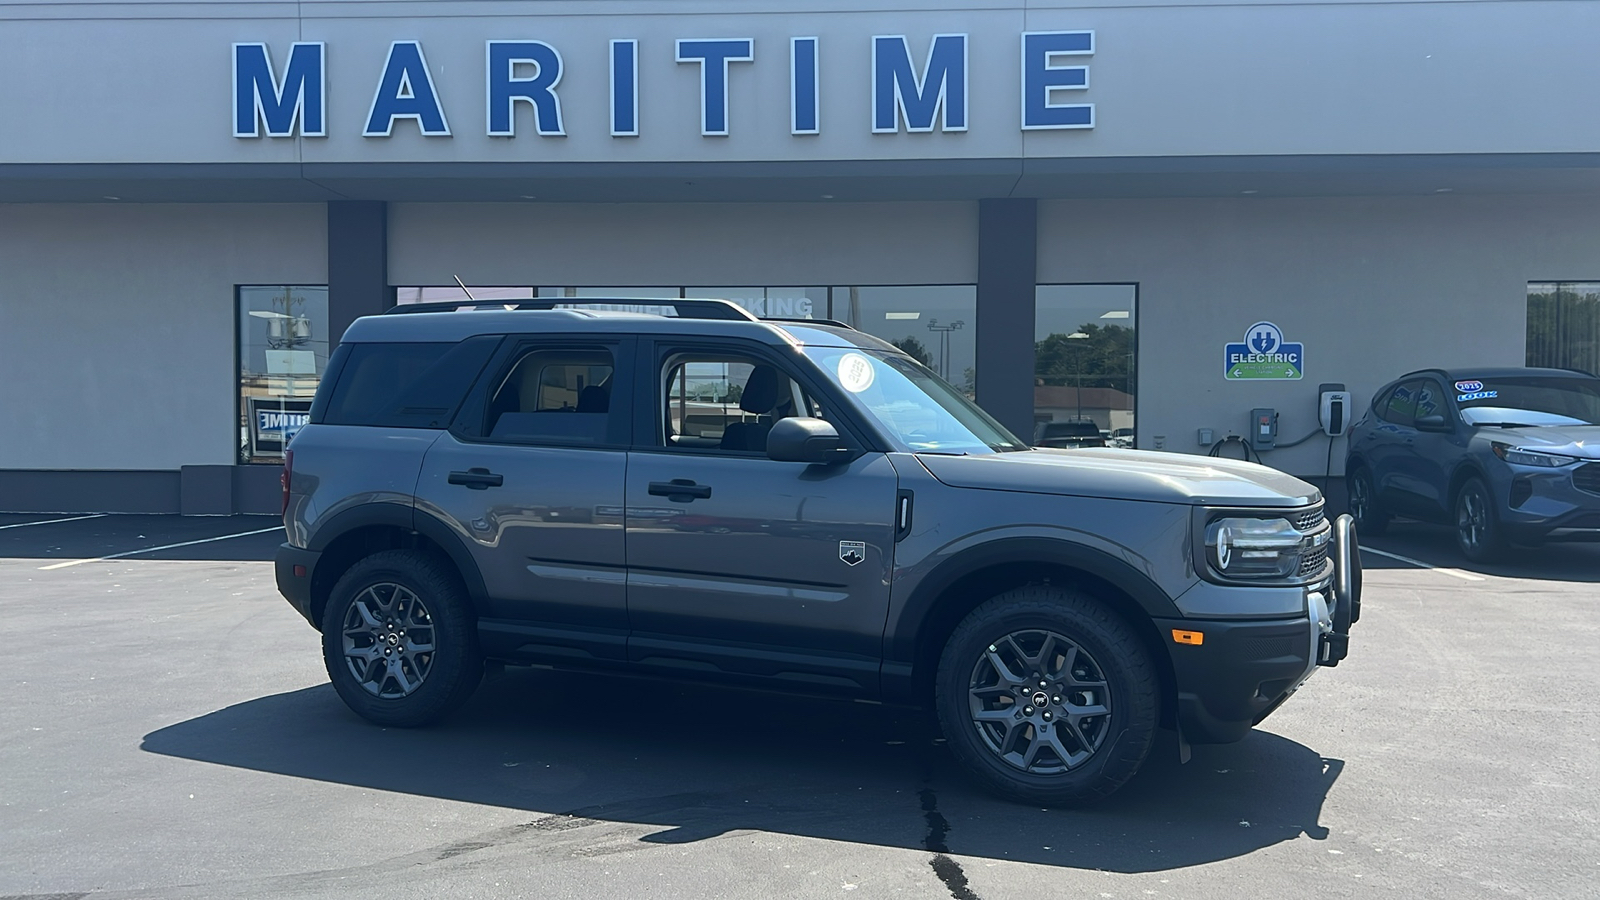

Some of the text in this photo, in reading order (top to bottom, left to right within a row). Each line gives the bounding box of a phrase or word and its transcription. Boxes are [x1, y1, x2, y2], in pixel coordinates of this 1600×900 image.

[231, 29, 1095, 138] MARITIME
[729, 298, 813, 316] RKING
[1230, 353, 1298, 363] ELECTRIC
[1457, 390, 1498, 402] LOOK
